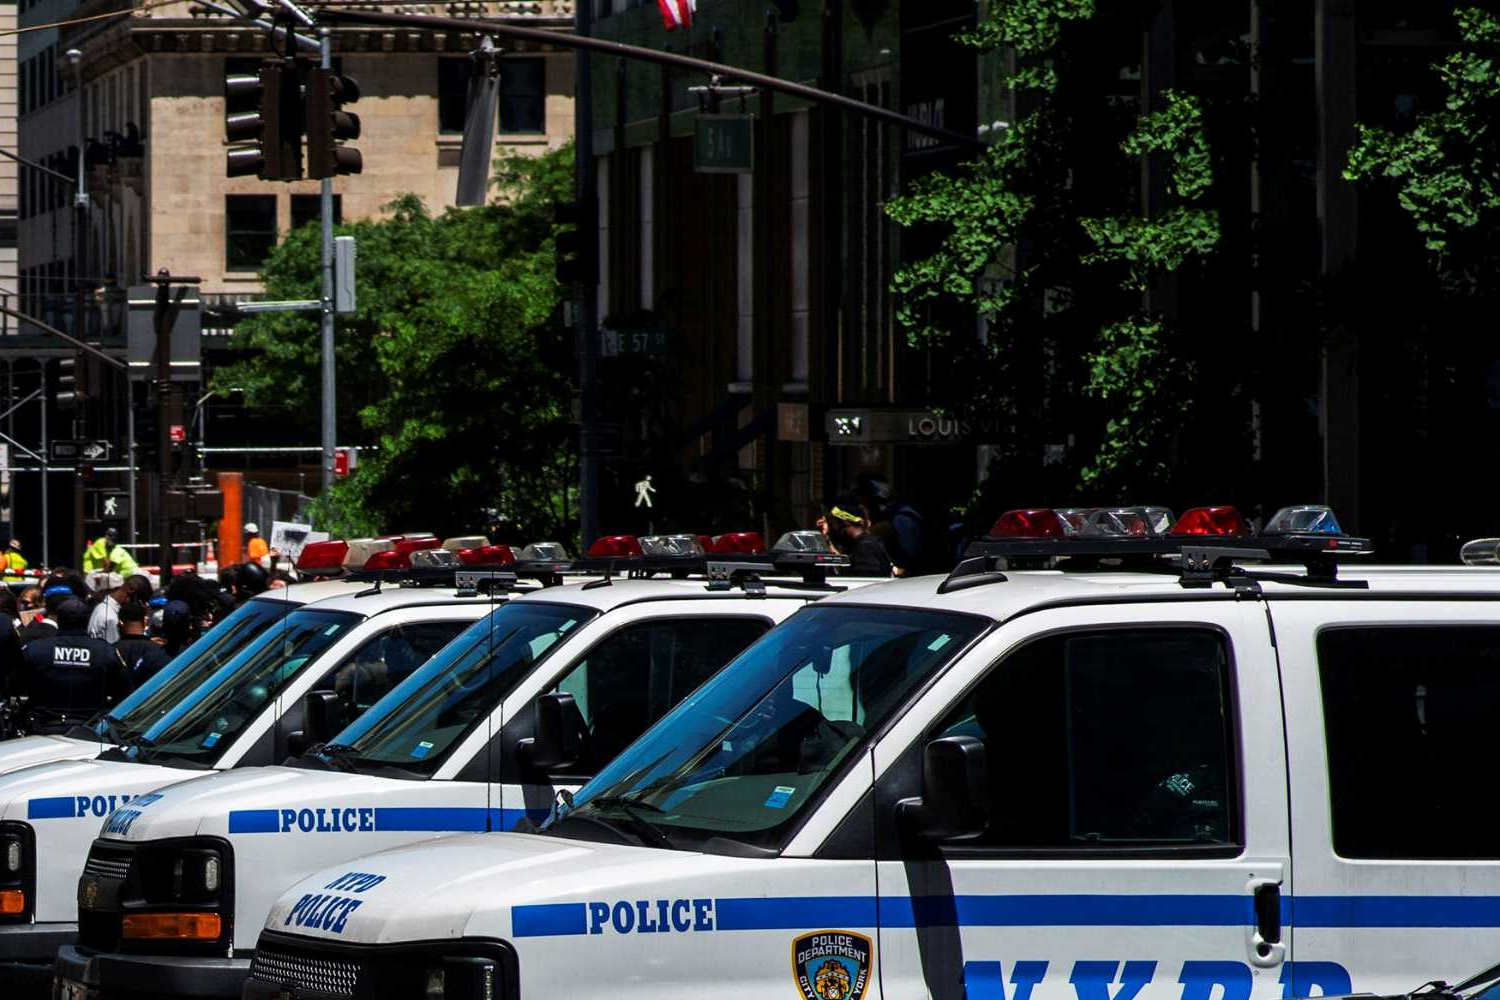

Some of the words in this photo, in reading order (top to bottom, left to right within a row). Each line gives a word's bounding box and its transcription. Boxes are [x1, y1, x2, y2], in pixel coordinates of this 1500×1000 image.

[631, 332, 649, 352] 57
[908, 417, 972, 437] LOUIS
[54, 646, 90, 662] NYPD
[281, 807, 374, 833] POLICE
[323, 872, 387, 893] NYPD
[283, 894, 363, 934] POLICE
[589, 898, 712, 935] POLICE
[812, 935, 853, 948] POLICE
[798, 945, 867, 965] DEPARTMENT
[800, 975, 815, 999] CITY
[853, 968, 869, 995] YORK
